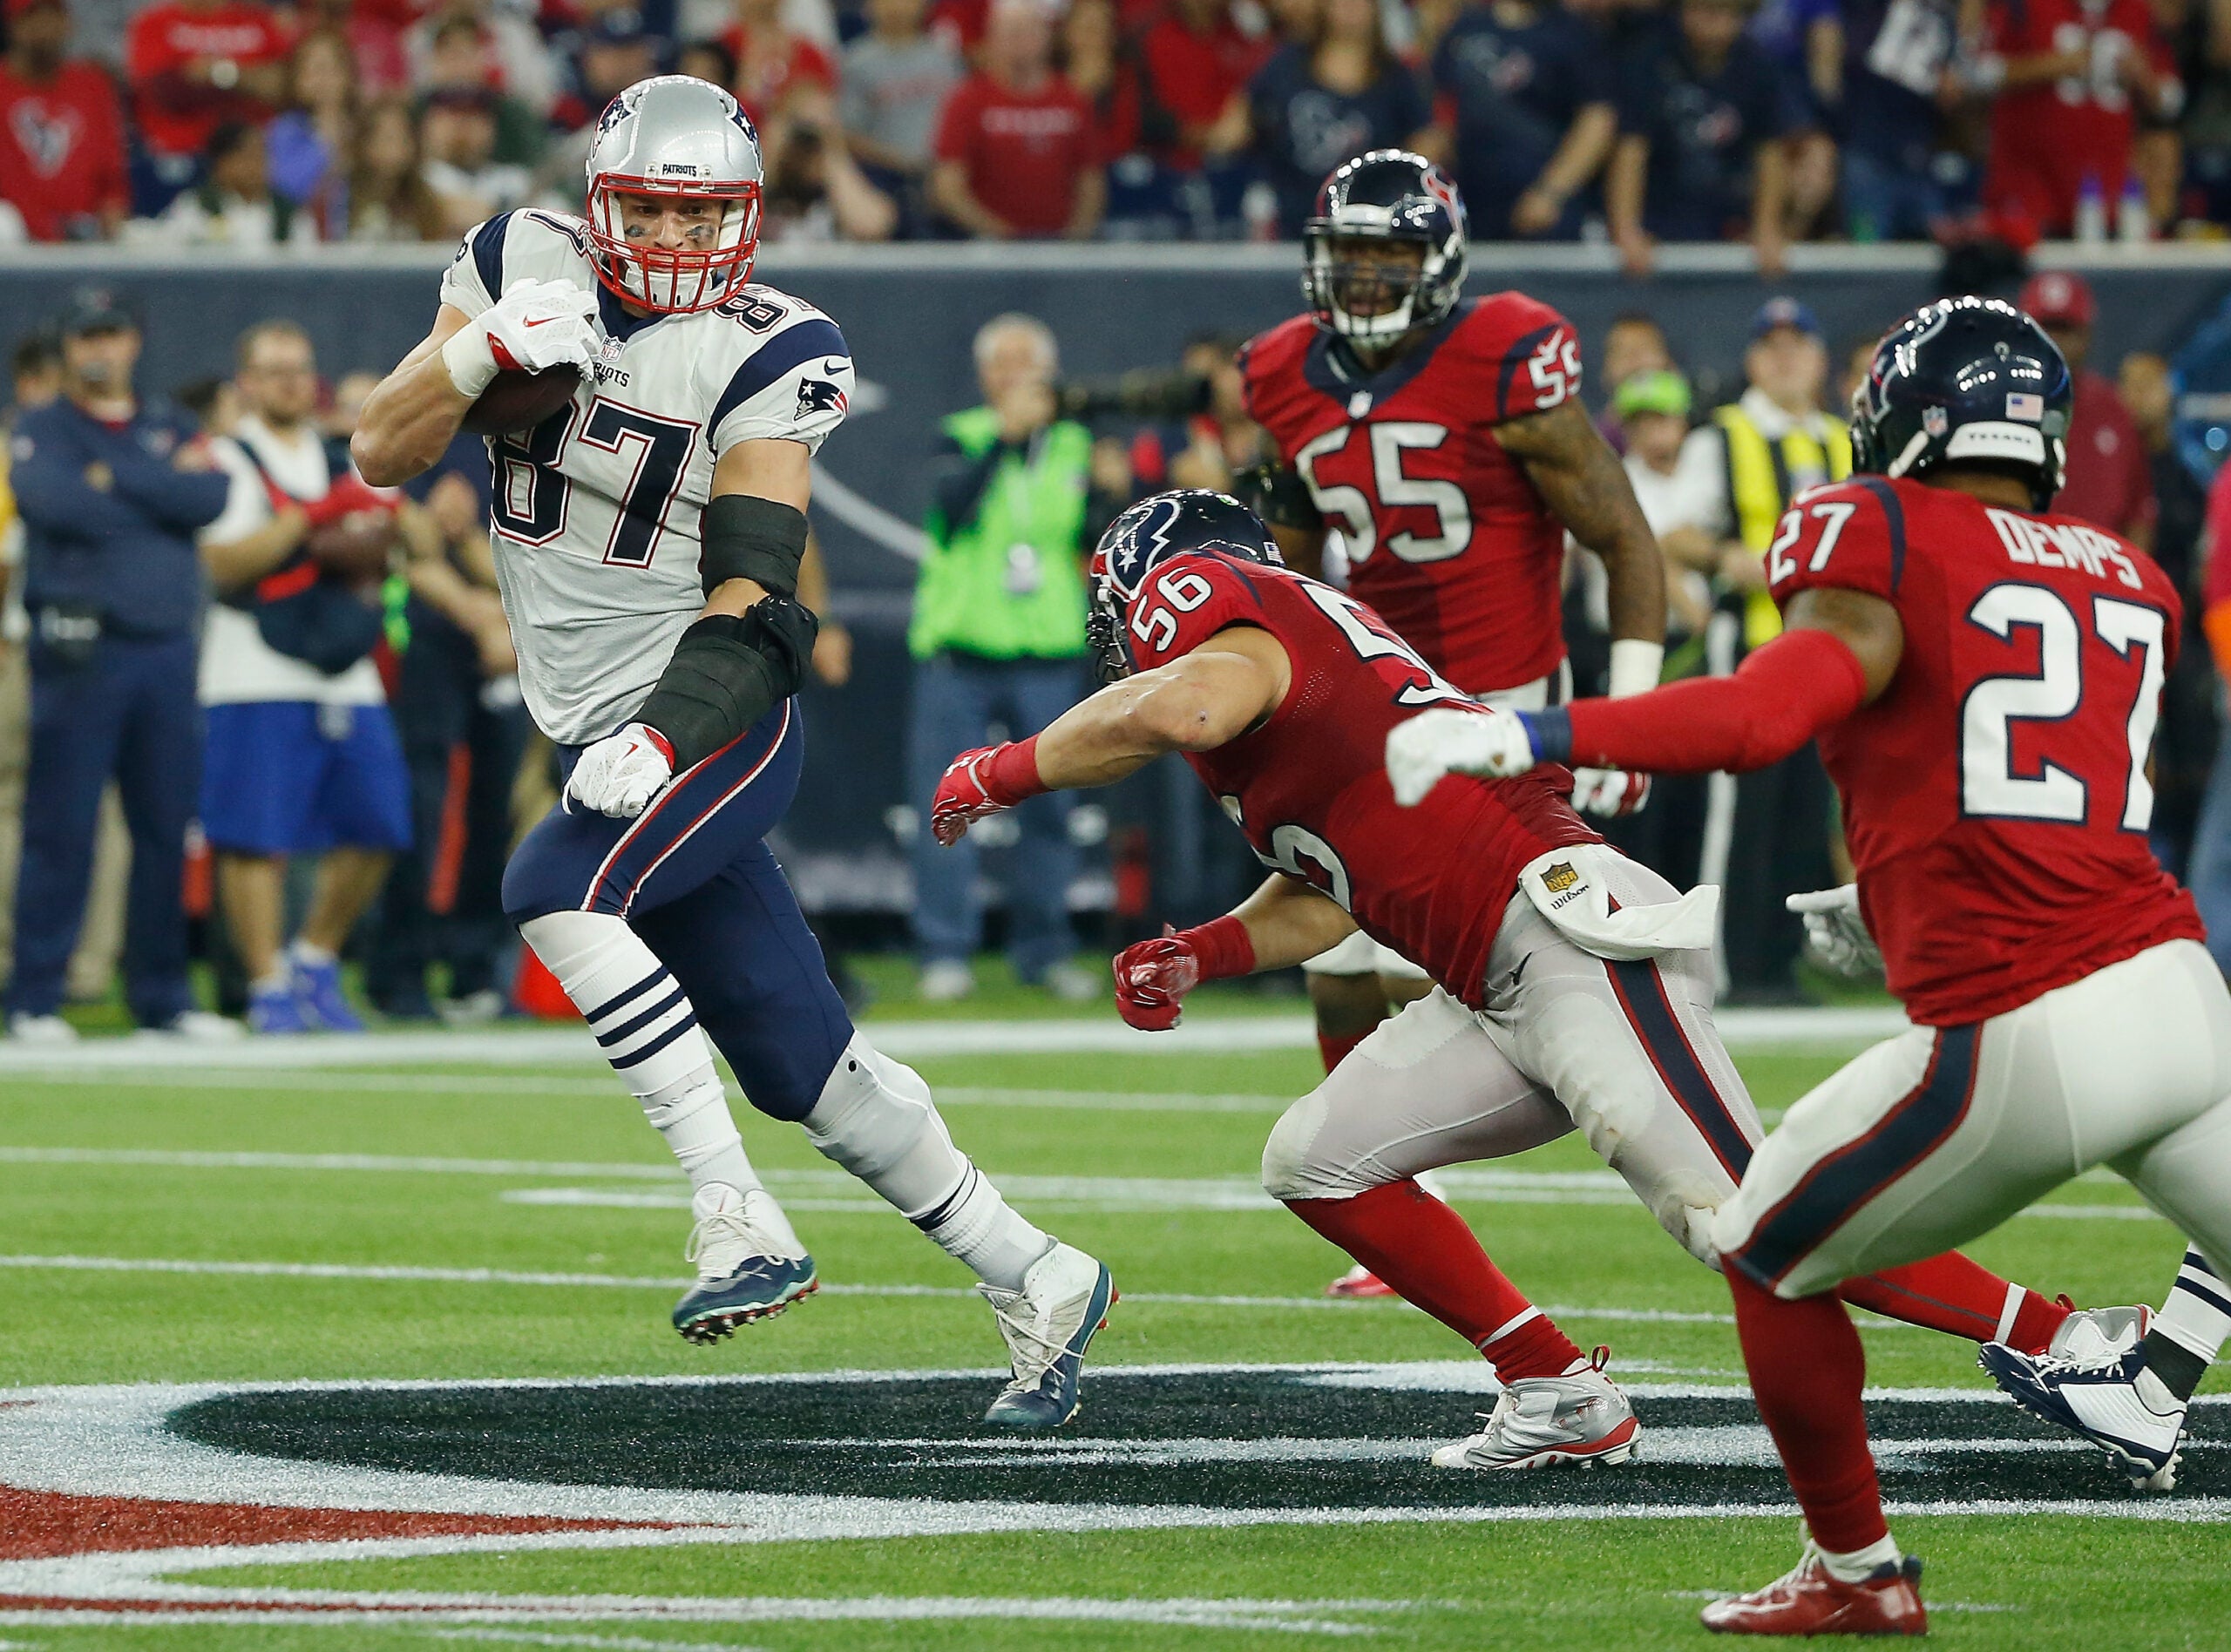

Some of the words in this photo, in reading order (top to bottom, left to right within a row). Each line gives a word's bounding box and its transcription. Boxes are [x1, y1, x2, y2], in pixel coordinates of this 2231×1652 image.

[662, 163, 697, 177] PATRIOTS
[593, 362, 630, 387] RIOTS
[490, 395, 702, 570] 87
[1293, 421, 1475, 565] 55
[1769, 500, 1857, 586] 27
[1985, 507, 2143, 590] DEMPS
[1131, 566, 1213, 652] 56
[1958, 580, 2167, 834] 27
[1551, 884, 1589, 910] Wilson
